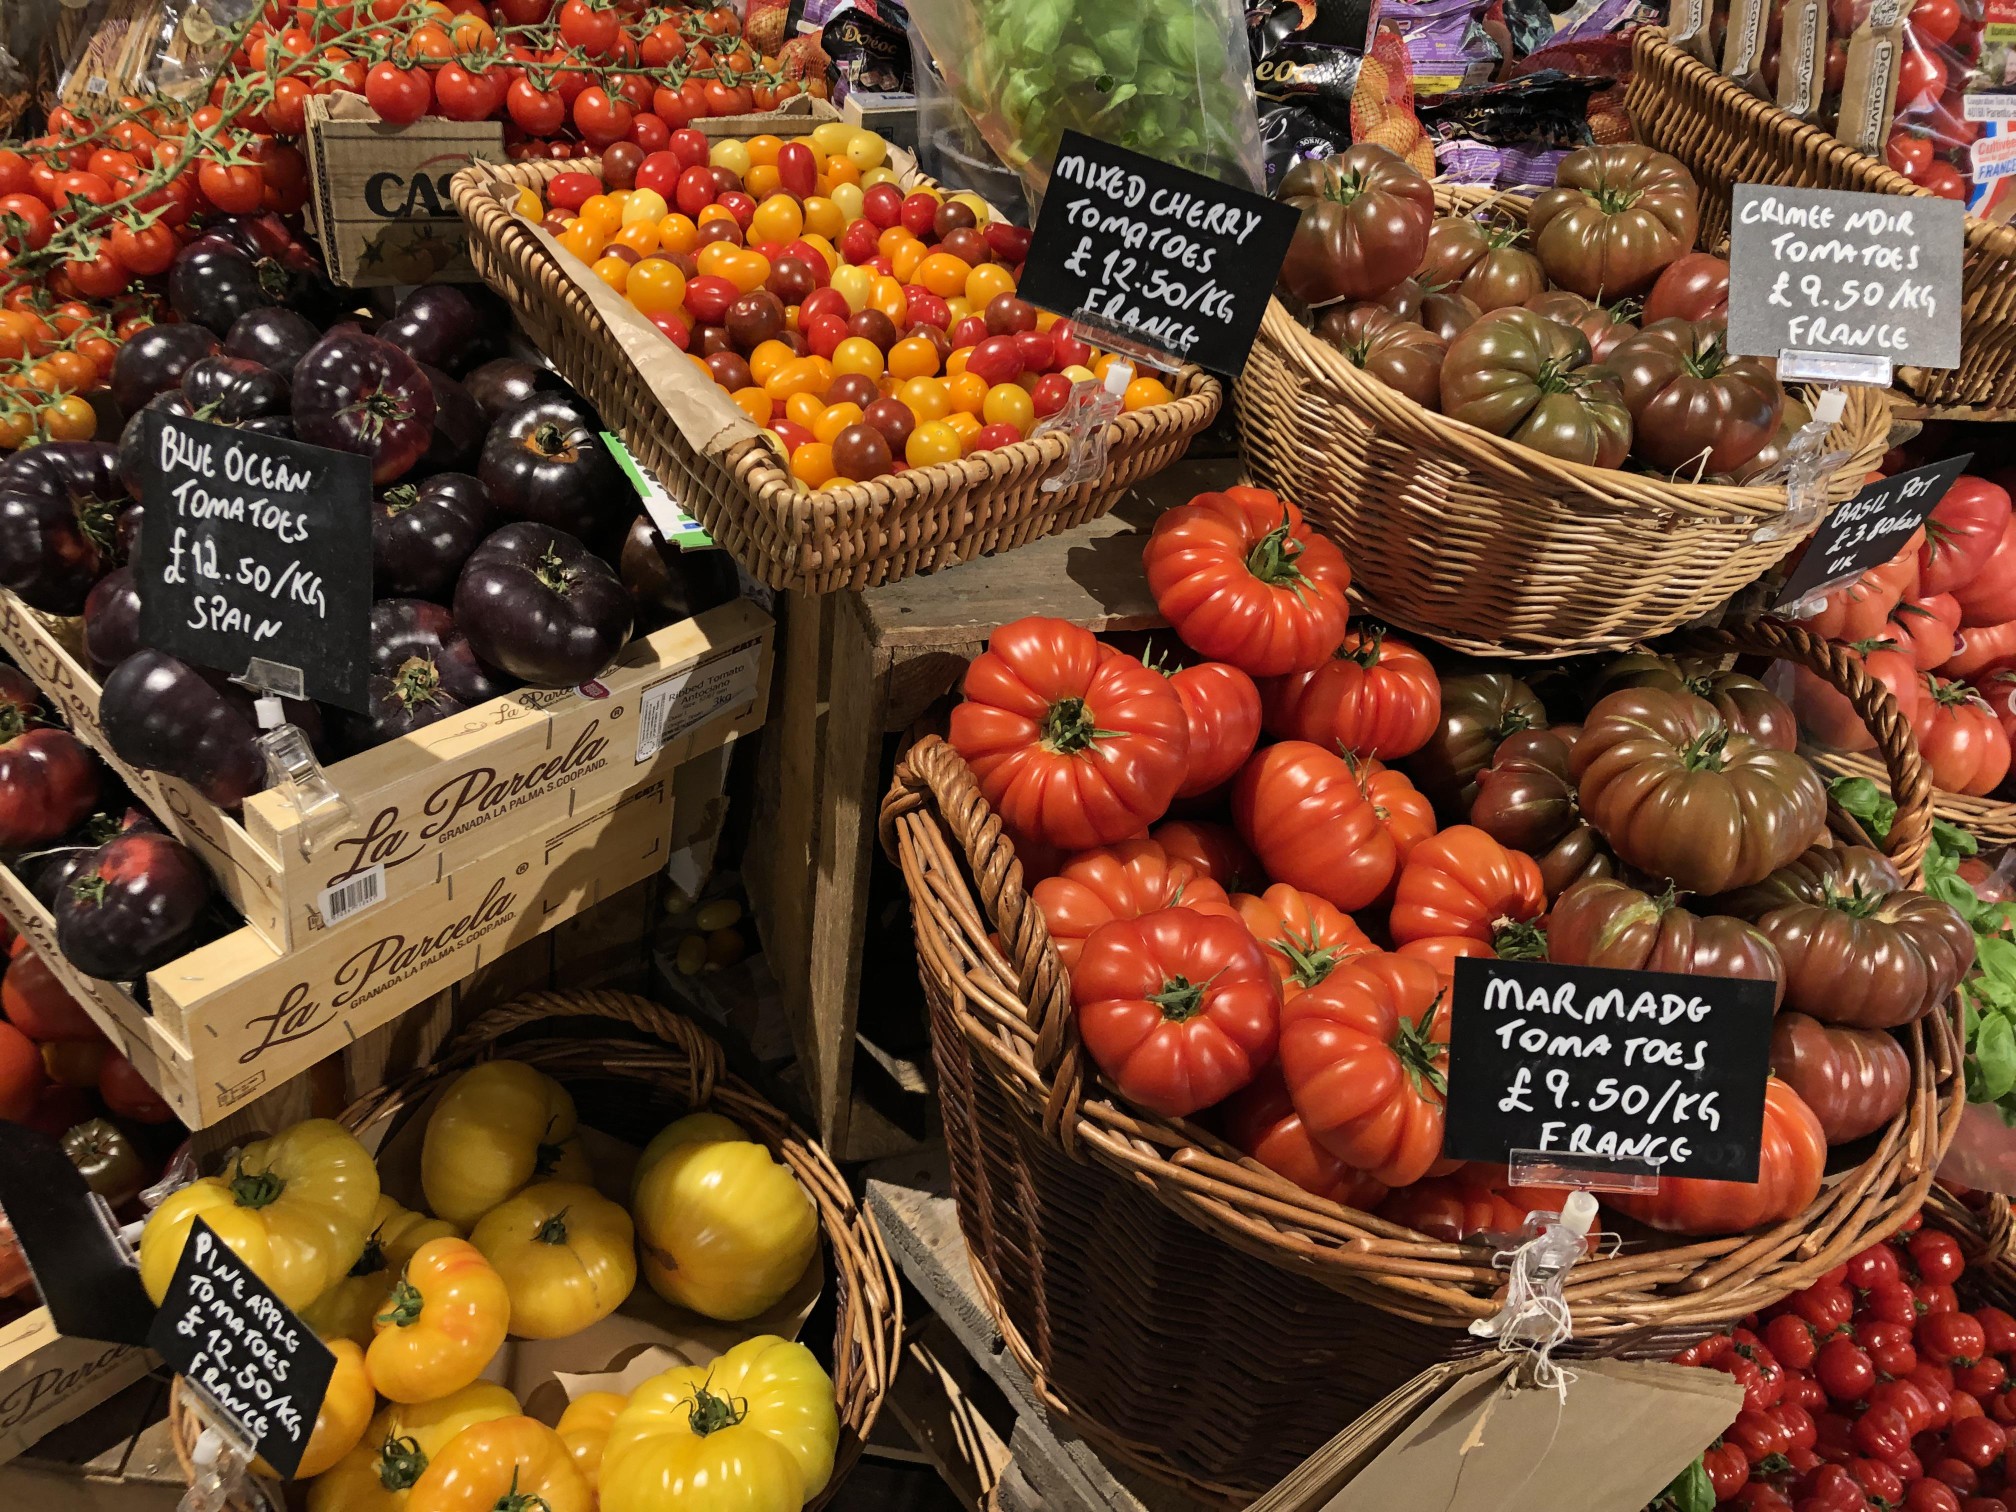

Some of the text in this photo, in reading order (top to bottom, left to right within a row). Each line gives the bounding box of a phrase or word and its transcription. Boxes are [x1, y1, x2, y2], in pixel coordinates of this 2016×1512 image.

[1800, 9, 1816, 110] Découvrez
[1867, 46, 1890, 153] Découvrez
[1056, 154, 1262, 245] MIXED CHERRY
[1740, 196, 1836, 230] CRIMEE
[1065, 198, 1217, 274] TOMATOES
[1770, 231, 1921, 272] TOMATOES
[1083, 287, 1200, 352] FRANCE
[1787, 314, 1910, 351] FRANCE
[160, 425, 313, 493] BLUE OCEAN
[171, 478, 309, 544] TOMATOES
[1831, 473, 1942, 529] BASIL POT
[1826, 553, 1859, 574] UK
[187, 594, 283, 642] SPAIN
[519, 685, 574, 711] Parce
[668, 680, 705, 702] Ribbed
[707, 664, 745, 685] Tomato
[327, 806, 426, 889] La
[419, 718, 611, 840] Parcela
[438, 812, 493, 845] GRANADA
[492, 802, 508, 820] LA
[508, 786, 545, 812] PALMA
[239, 876, 518, 1065] La Parcela
[350, 974, 404, 1010] GRANADA
[403, 965, 419, 981] LA
[419, 943, 457, 971] PALMA
[1494, 1017, 1709, 1072] TOMATOES
[1538, 1120, 1693, 1167] FRANCE
[188, 1273, 292, 1383] TOMATOES
[187, 1350, 270, 1439] FRANCE
